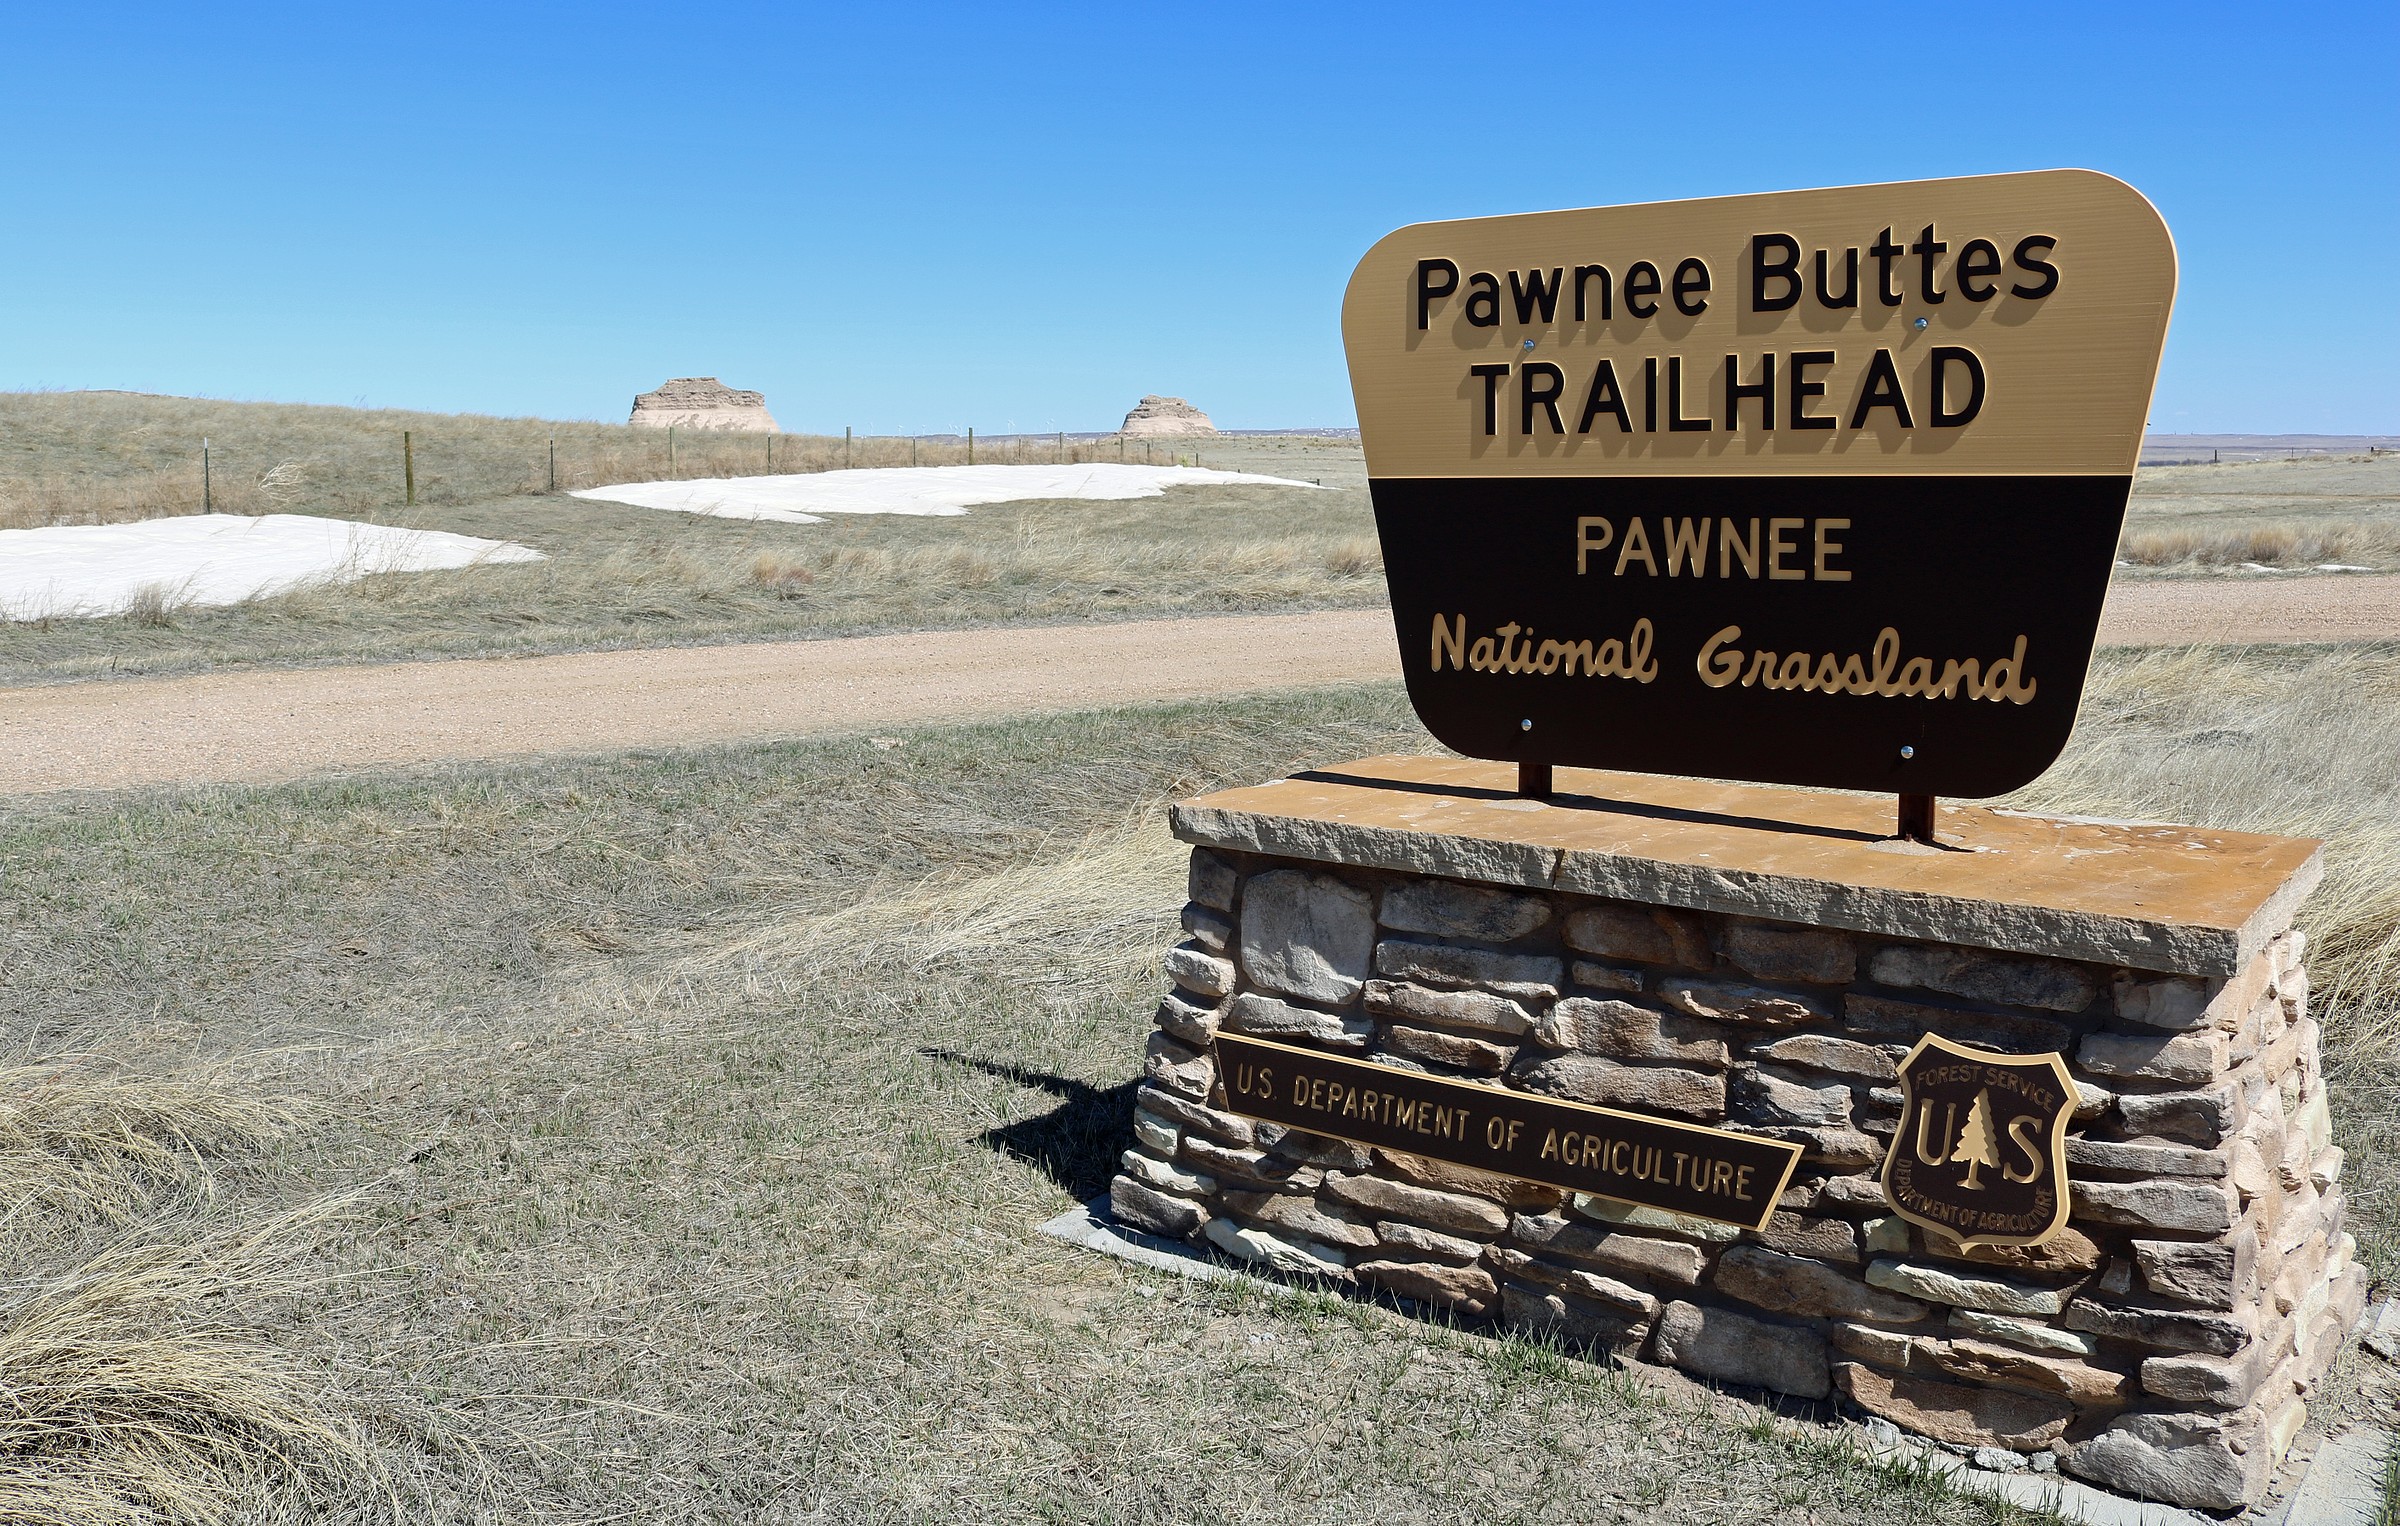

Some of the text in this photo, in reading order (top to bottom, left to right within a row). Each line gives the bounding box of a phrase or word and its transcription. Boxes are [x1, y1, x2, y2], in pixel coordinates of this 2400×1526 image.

[1417, 223, 2061, 330] Pawnee Buttes
[1471, 346, 1987, 436] TRAILHEAD
[1577, 516, 1852, 581] PAWNEE
[1431, 613, 2036, 706] National Grassland
[1915, 1064, 2055, 1113] FOREST SERVICE
[1292, 1075, 1471, 1143] DEPARTMENT
[1486, 1116, 1525, 1153] OF
[1540, 1128, 1756, 1200] AGRICULTURE
[1896, 1158, 2054, 1232] DEPARTMENT OF AGRICULTURE
